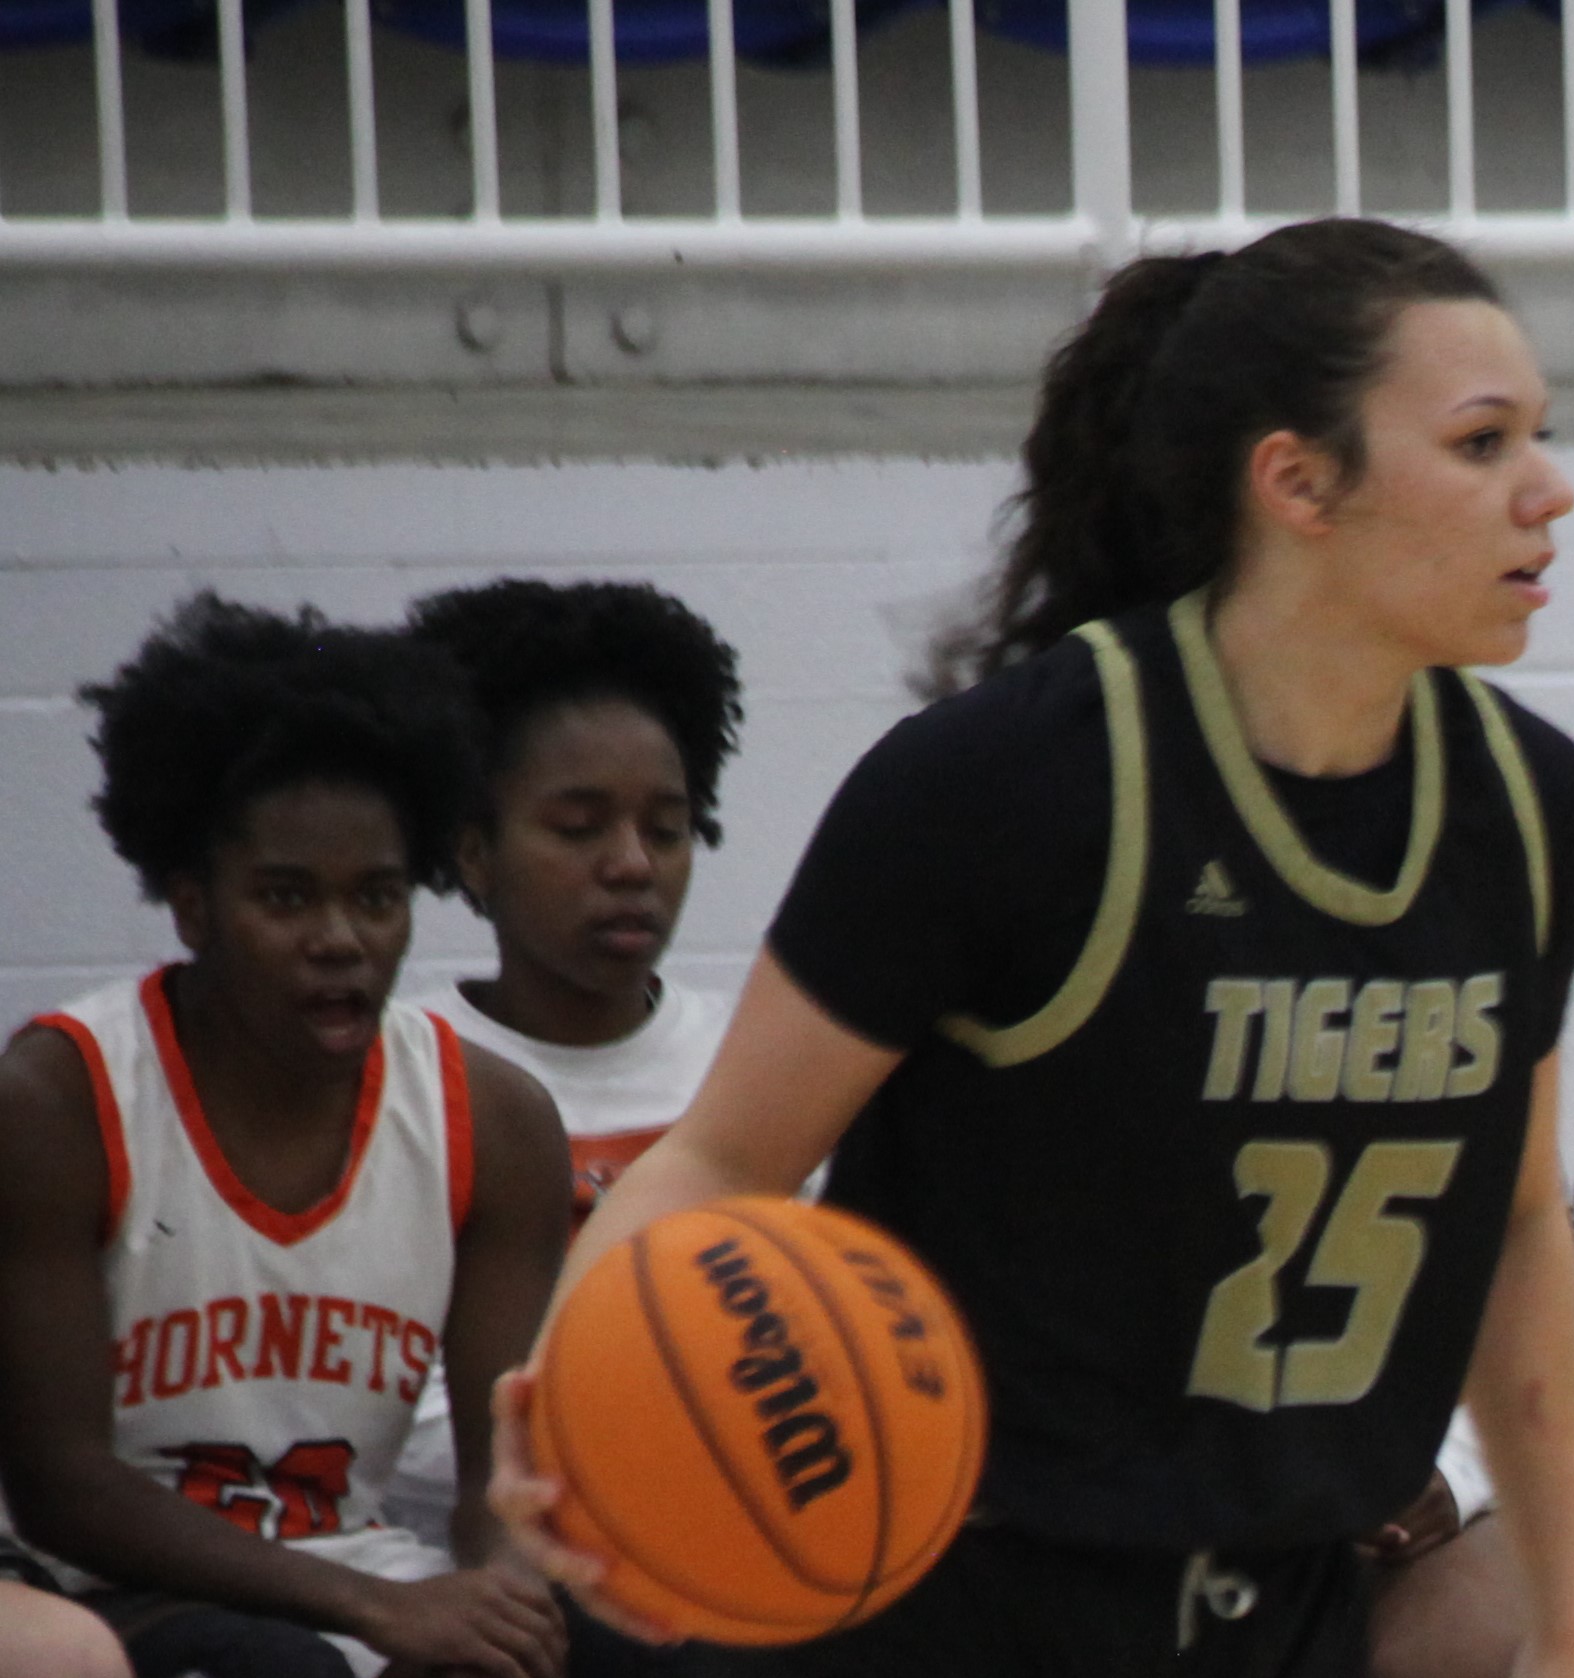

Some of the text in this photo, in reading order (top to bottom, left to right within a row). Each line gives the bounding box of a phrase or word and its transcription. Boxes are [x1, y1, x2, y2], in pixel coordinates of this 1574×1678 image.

[1203, 972, 1504, 1102] TIGERS
[113, 1291, 437, 1408] HORNETS
[694, 1237, 853, 1514] Wilson
[1186, 1139, 1464, 1412] 25
